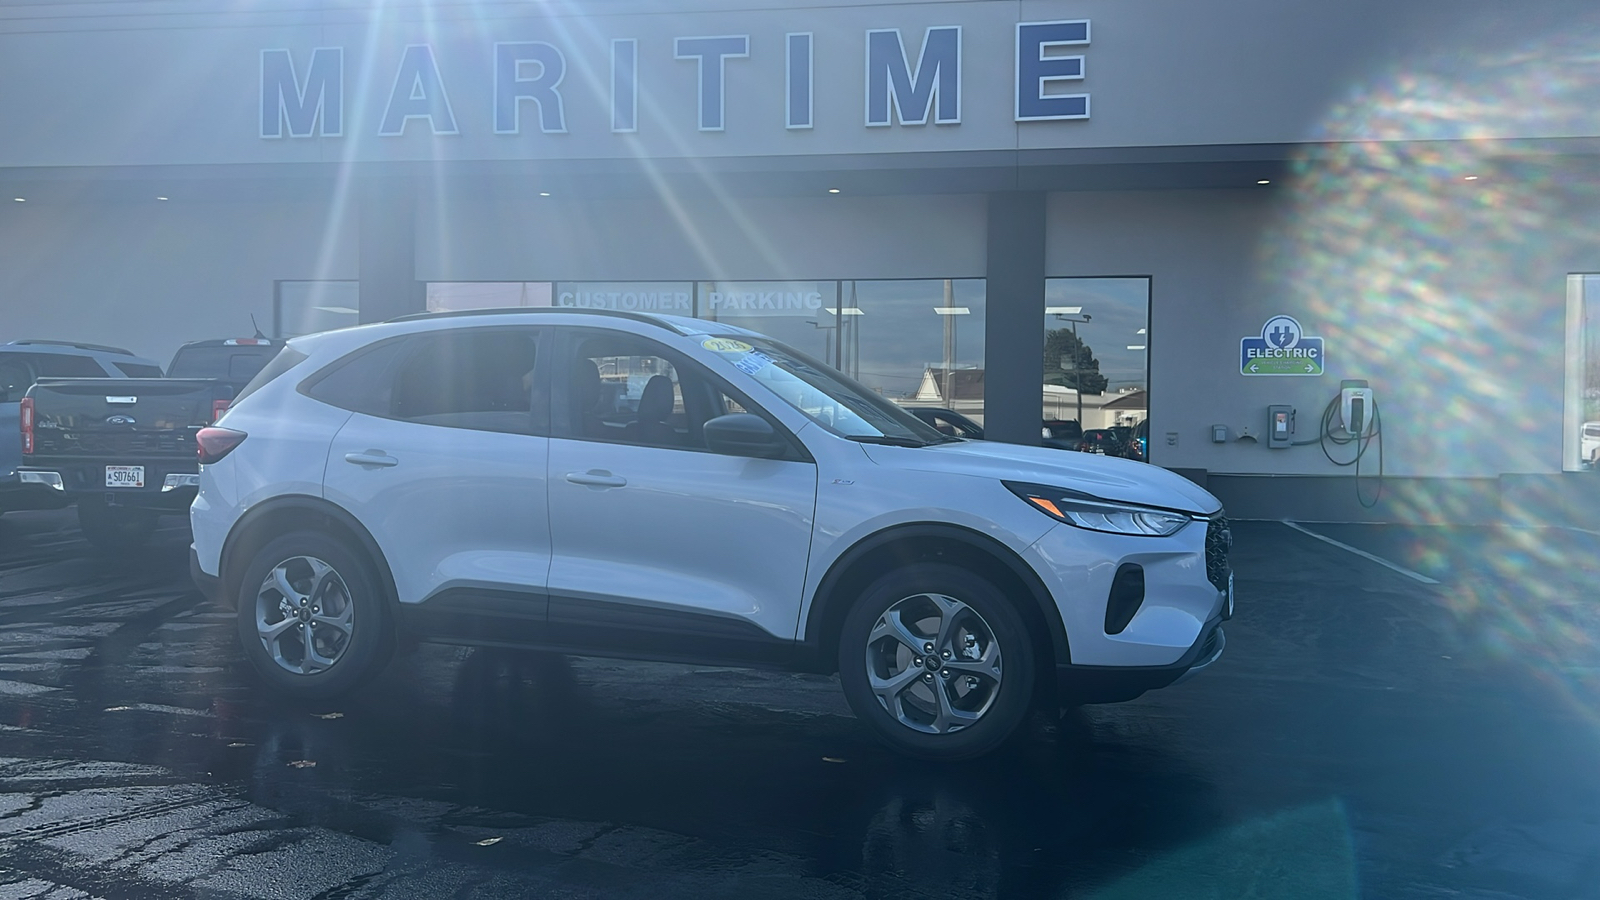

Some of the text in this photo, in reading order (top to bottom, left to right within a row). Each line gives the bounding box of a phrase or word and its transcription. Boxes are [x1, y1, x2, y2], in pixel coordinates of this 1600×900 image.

[258, 19, 1091, 139] MARITIME
[559, 291, 822, 310] CUSTOMER PARKING
[1247, 348, 1318, 358] ELECTRIC
